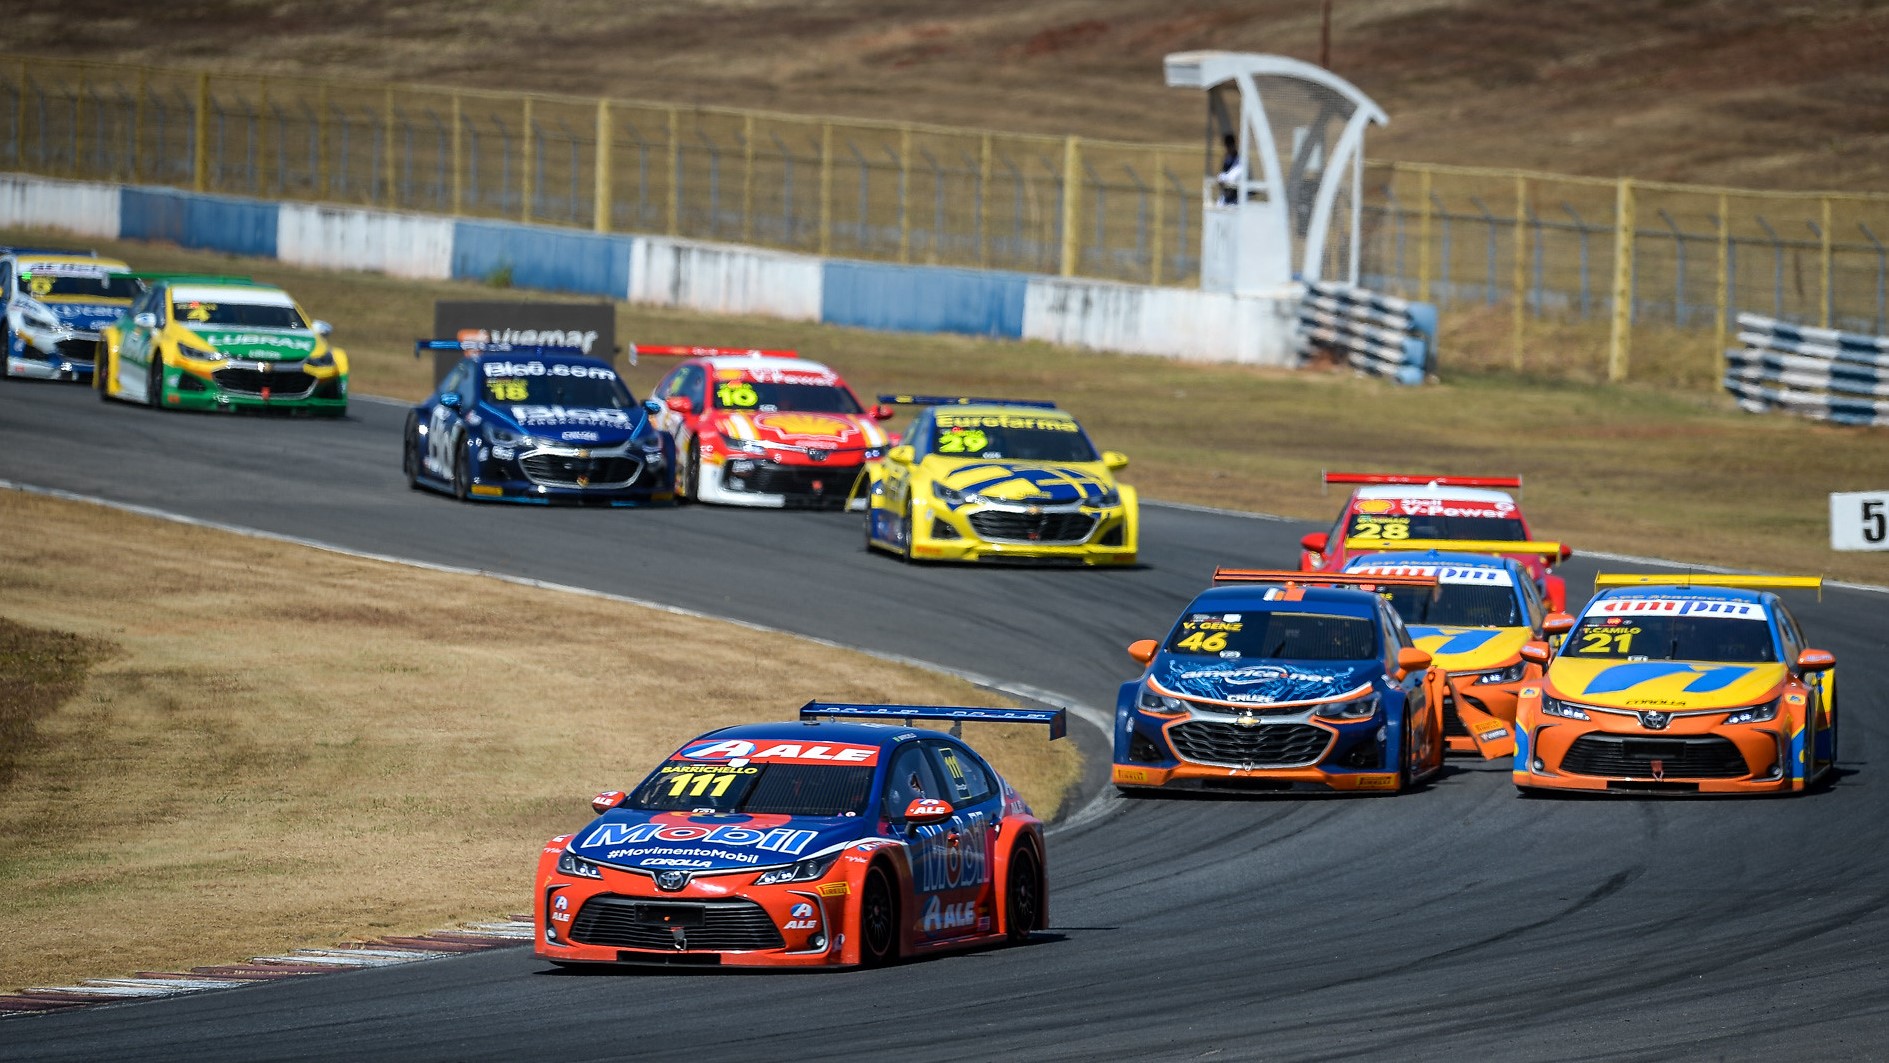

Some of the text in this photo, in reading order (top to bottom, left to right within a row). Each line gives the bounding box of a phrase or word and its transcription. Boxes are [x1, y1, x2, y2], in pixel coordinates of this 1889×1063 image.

[490, 383, 529, 401] 18
[717, 385, 758, 407] 10
[935, 415, 1081, 432] Eurofarma
[938, 432, 988, 453] 29
[1352, 523, 1409, 540] 28
[1862, 502, 1886, 544] 5
[1200, 622, 1244, 632] GENZ
[1177, 631, 1229, 652] 46
[1579, 633, 1633, 653] 21
[752, 744, 876, 762] ALE
[660, 766, 759, 775] BARRICHELLO
[667, 773, 737, 797] 111
[913, 806, 946, 815] ALE
[580, 823, 819, 856] Mobil
[607, 848, 760, 865] #MovimentoMobil
[640, 858, 713, 868] COROLLA
[552, 912, 571, 922] ALE
[943, 900, 977, 929] ALE
[783, 920, 818, 930] ALE
